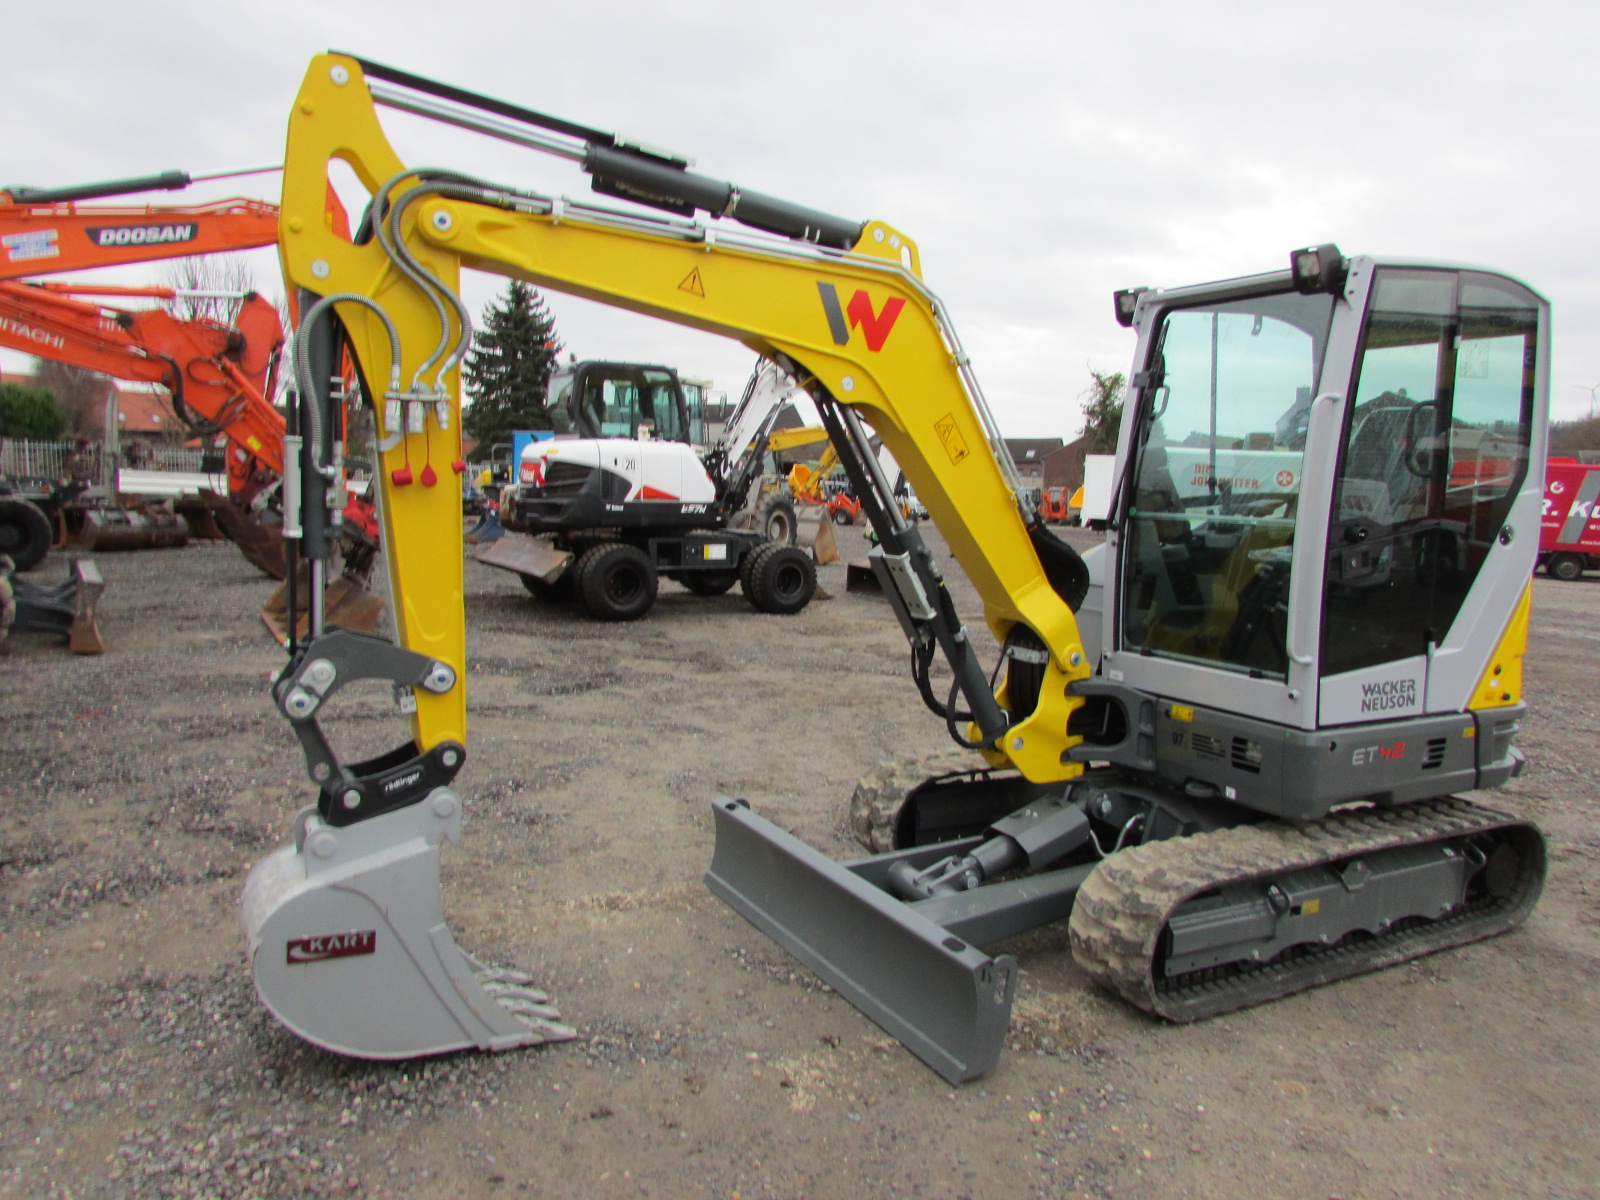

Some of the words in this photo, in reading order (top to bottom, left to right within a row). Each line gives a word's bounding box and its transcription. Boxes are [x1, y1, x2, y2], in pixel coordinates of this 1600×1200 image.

[100, 225, 191, 246] DOOSAN
[0, 317, 65, 349] ITACHI
[625, 460, 636, 470] 20
[1191, 476, 1259, 489] JOHITER
[1361, 679, 1416, 698] WACKER
[1361, 693, 1416, 713] NEUSON
